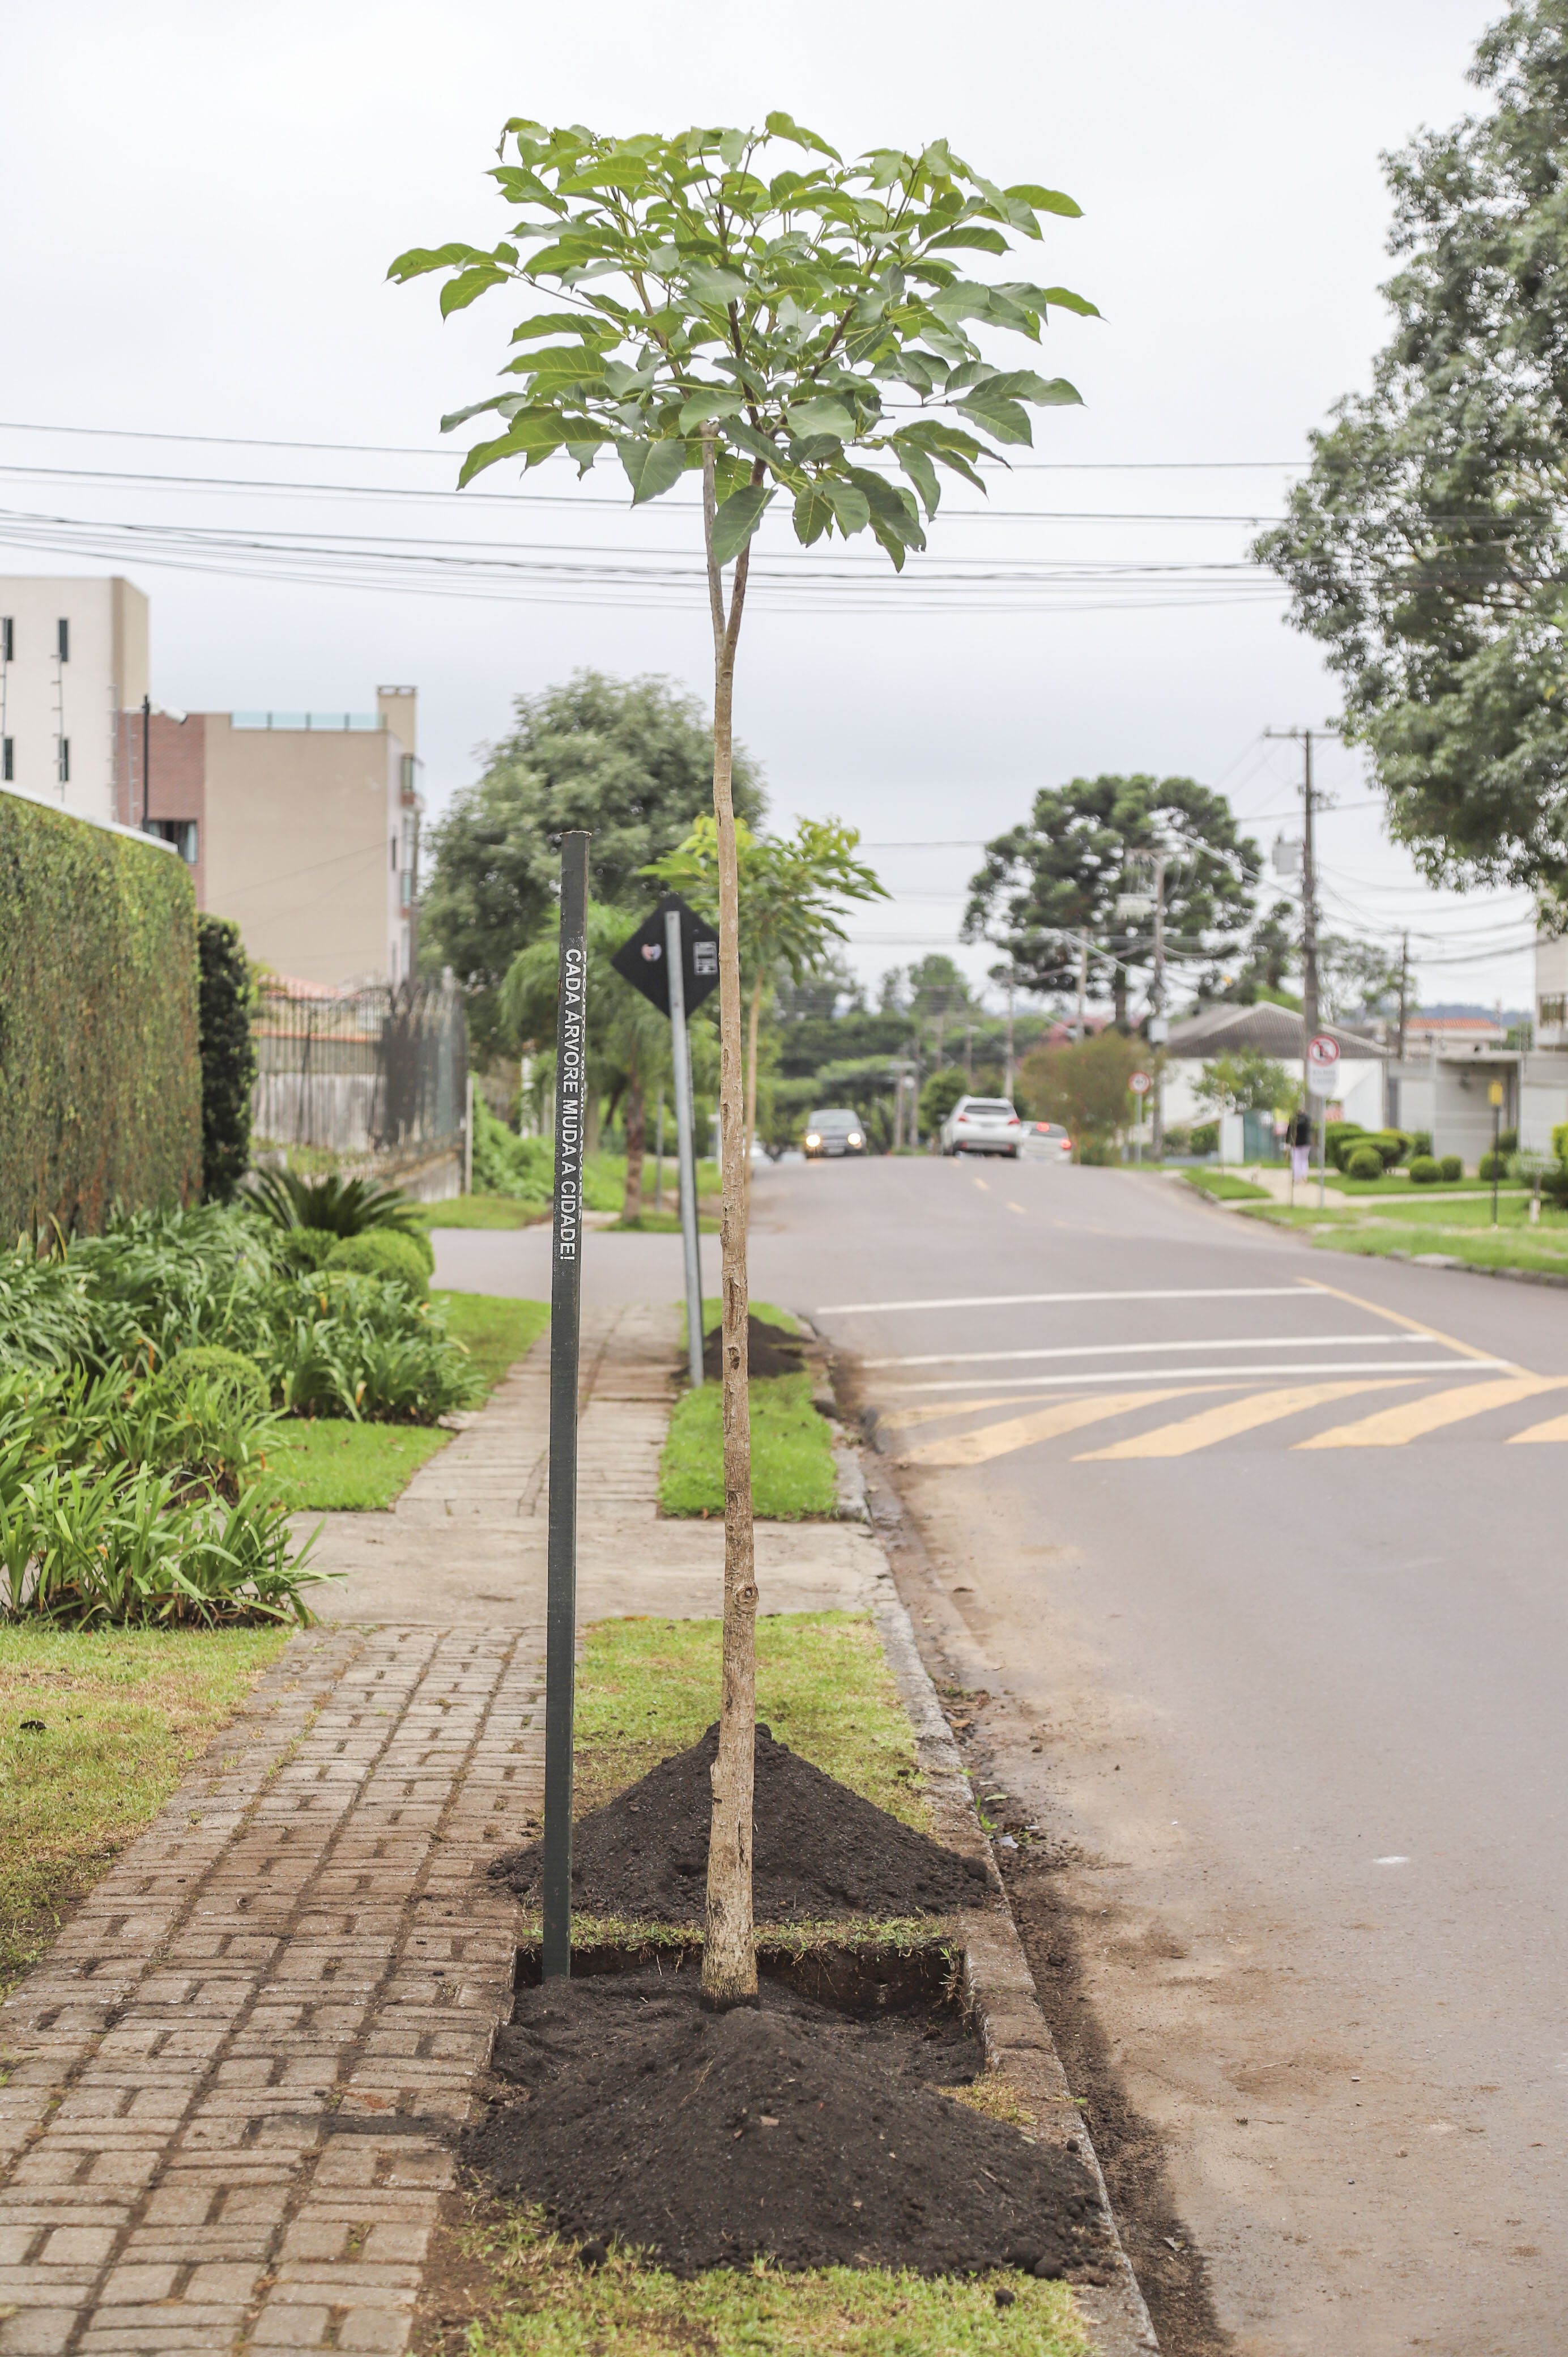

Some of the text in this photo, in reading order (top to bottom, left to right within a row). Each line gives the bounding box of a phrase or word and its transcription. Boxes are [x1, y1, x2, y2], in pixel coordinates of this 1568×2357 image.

[560, 948, 582, 1260] CADA ÁRVORE MUDA A CIDADE!
